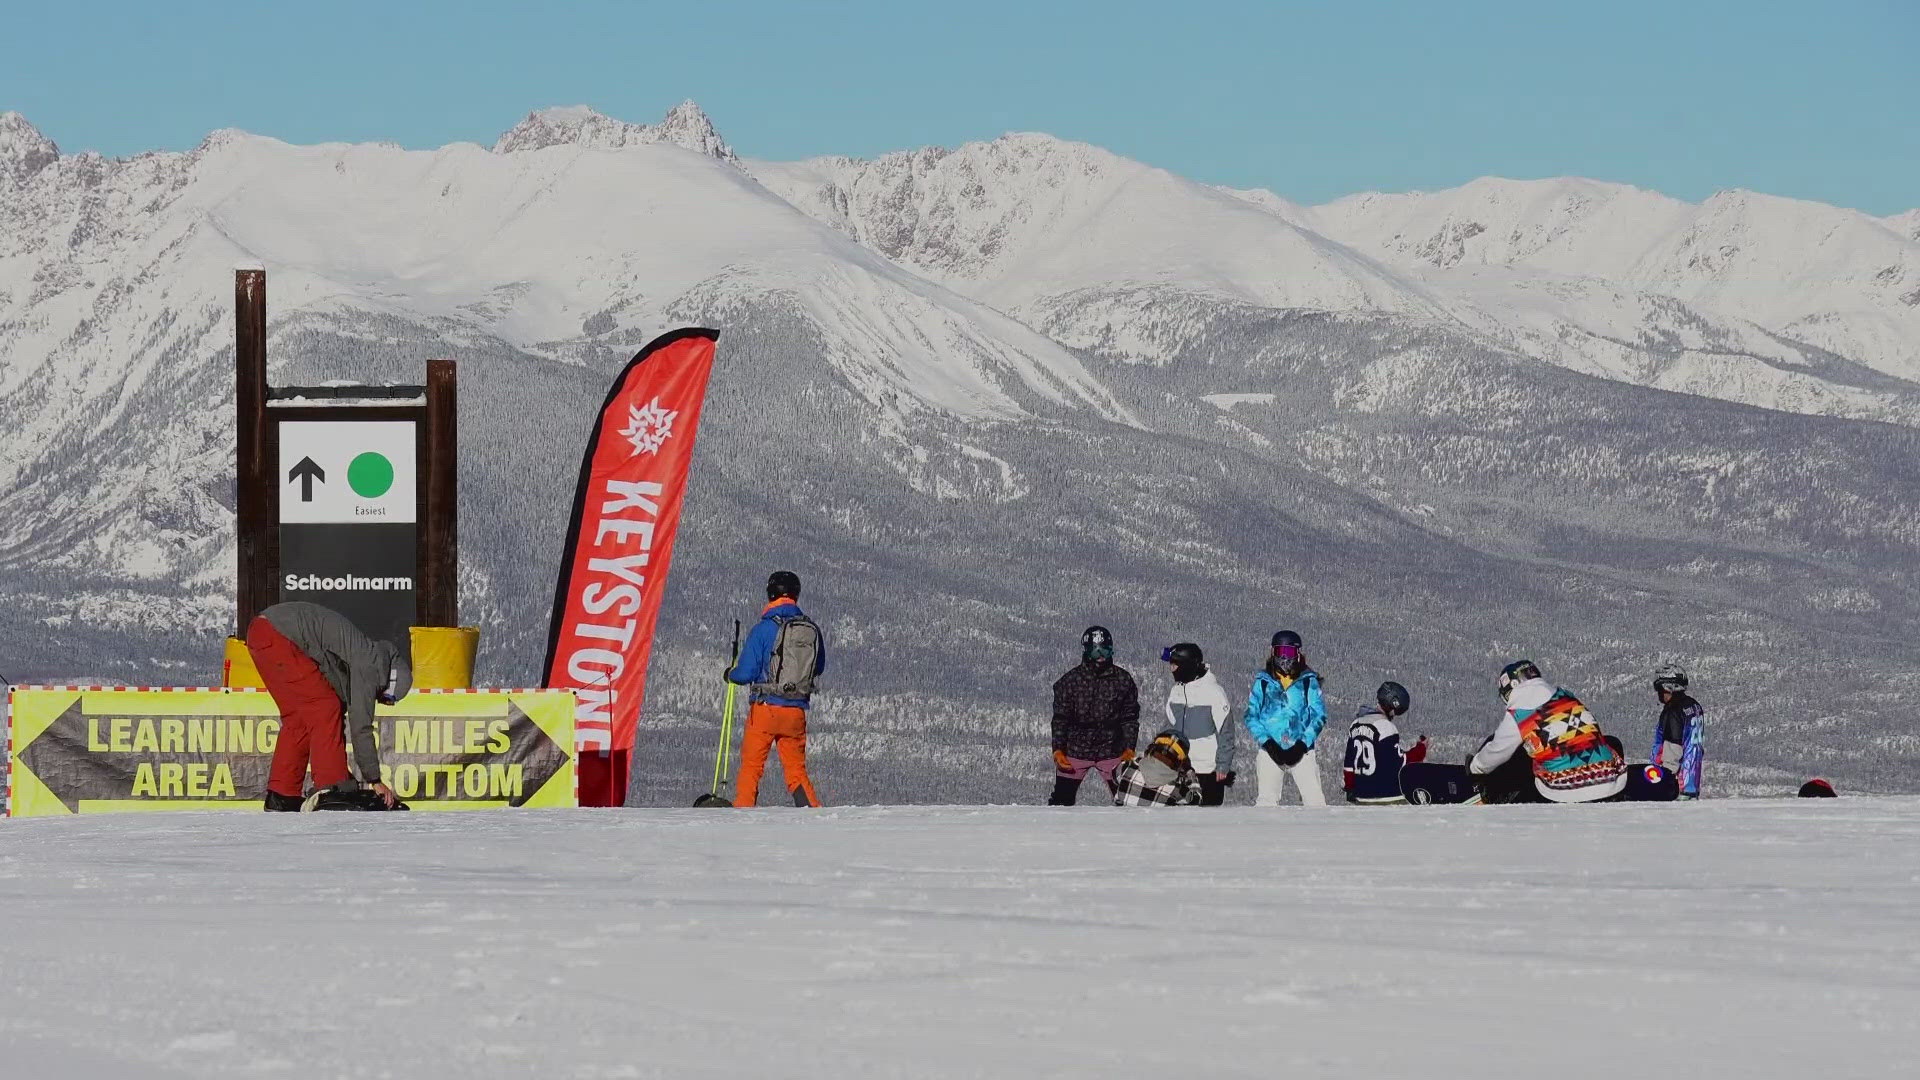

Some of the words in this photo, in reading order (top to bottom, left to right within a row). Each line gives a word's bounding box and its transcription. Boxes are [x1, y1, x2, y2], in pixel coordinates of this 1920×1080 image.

[355, 506, 386, 516] Easiest
[285, 573, 412, 591] Schoolmarm
[567, 478, 663, 758] KEYSTONE
[88, 718, 281, 754] LEARNING
[394, 718, 511, 754] MILES
[1353, 739, 1376, 776] 29
[131, 762, 235, 797] AREA
